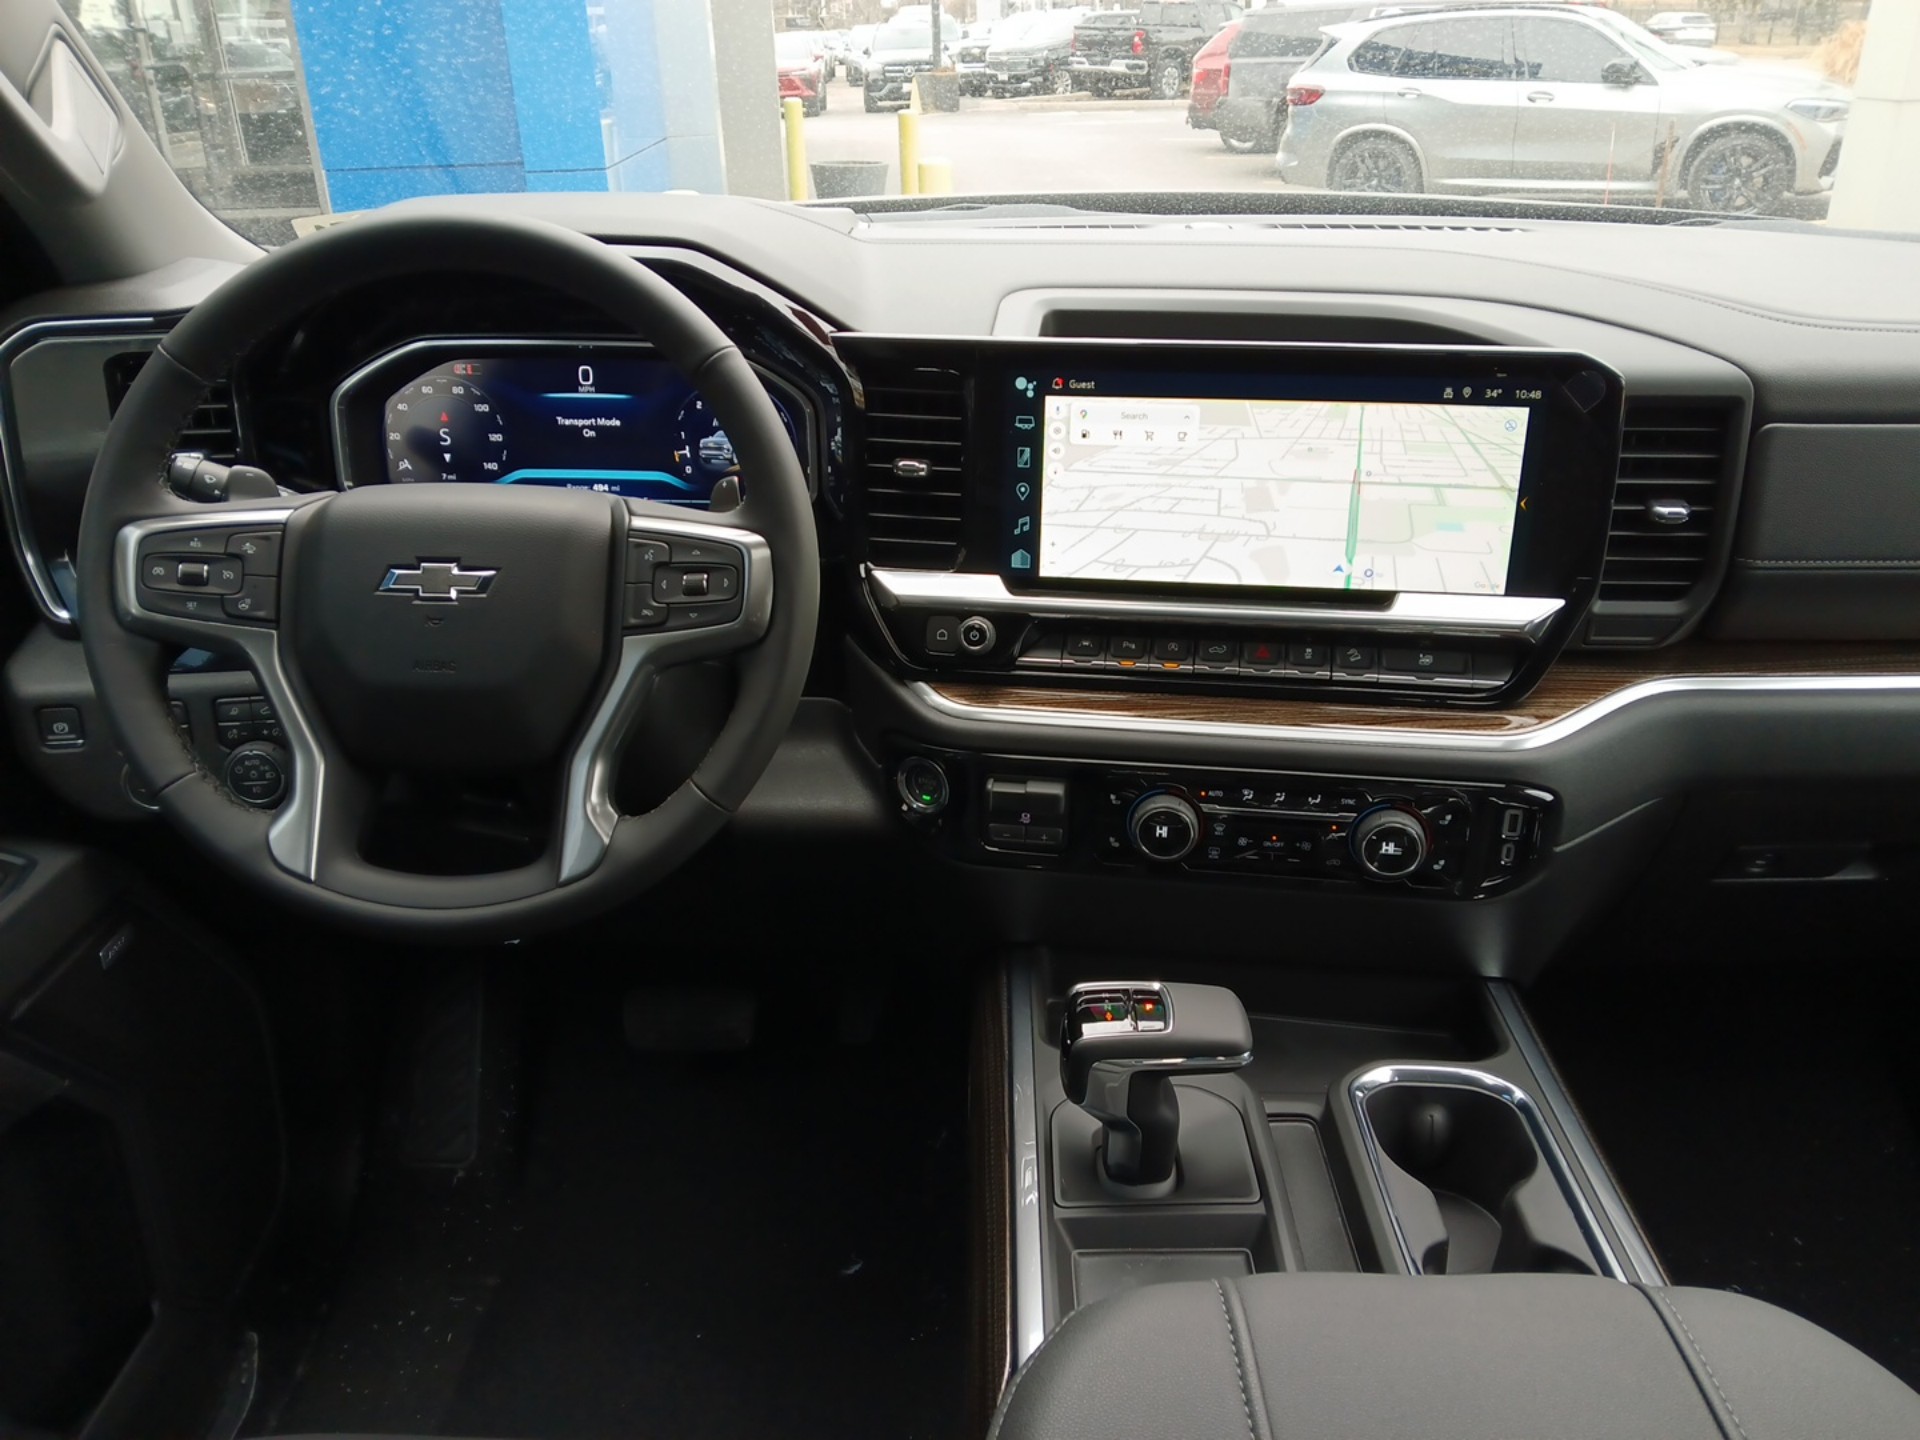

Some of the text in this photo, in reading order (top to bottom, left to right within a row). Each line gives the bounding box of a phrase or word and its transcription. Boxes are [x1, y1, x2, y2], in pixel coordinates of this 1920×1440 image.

[578, 365, 593, 385] 0
[1069, 379, 1096, 390] Guest
[421, 385, 433, 394] 60
[452, 385, 464, 394] 80
[1485, 388, 1542, 399] 34° 10:48
[397, 403, 408, 411] 40
[474, 403, 490, 412] 100
[1120, 411, 1148, 421] Search
[556, 416, 621, 428] Transport Mode
[389, 432, 401, 441] 20
[439, 428, 452, 445] S
[488, 433, 503, 442] 120
[582, 429, 596, 438] On
[483, 462, 499, 471] 140
[592, 483, 609, 492] 494
[1341, 798, 1356, 806] SYNC
[1156, 825, 1168, 839] HI
